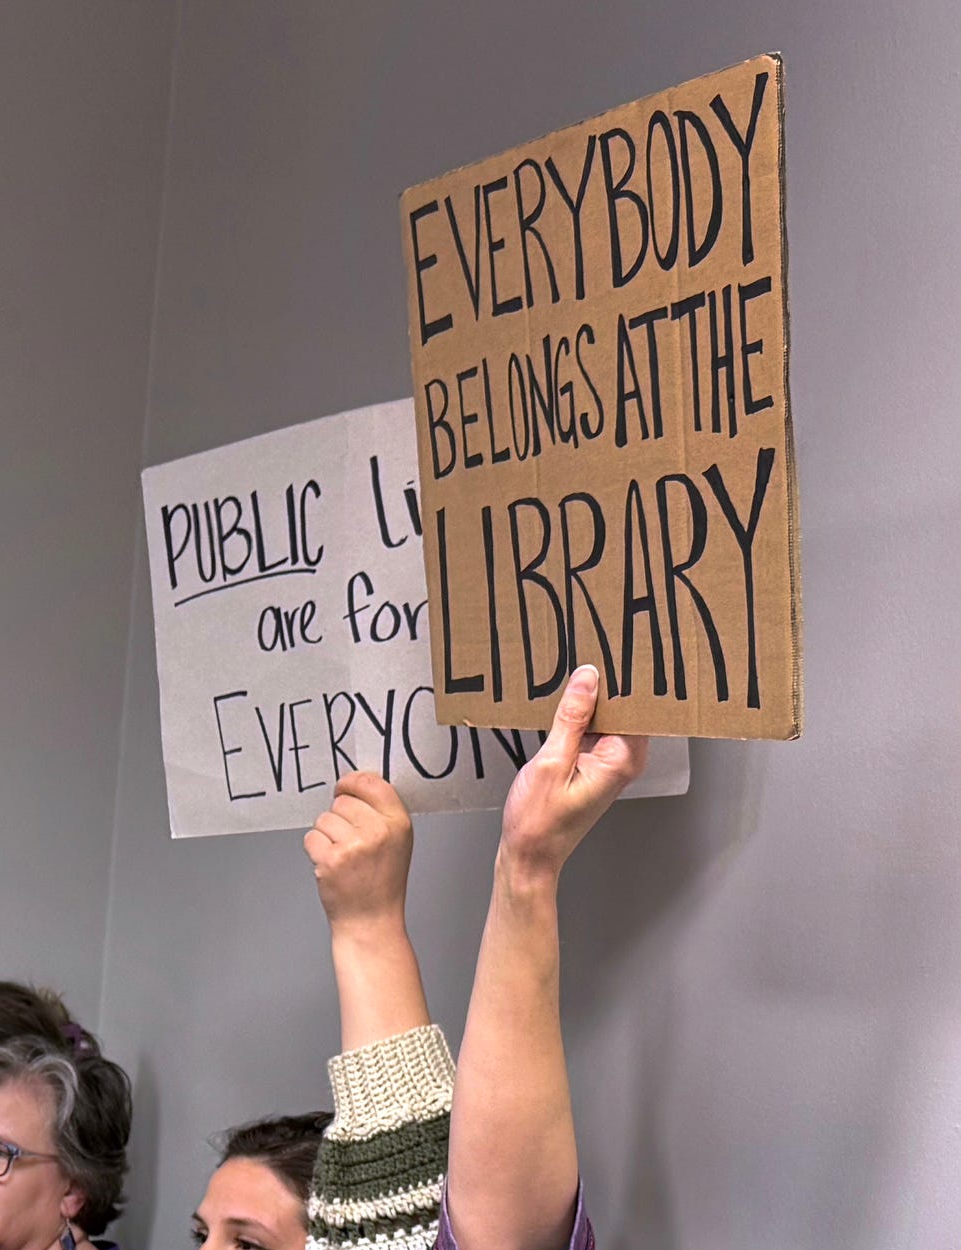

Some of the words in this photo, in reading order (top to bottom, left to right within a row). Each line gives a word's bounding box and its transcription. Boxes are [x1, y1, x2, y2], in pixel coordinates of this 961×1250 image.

[409, 72, 768, 347] EVERYBODY
[424, 323, 605, 480] BELONGS
[614, 305, 670, 449] AT
[671, 276, 775, 439] THE
[160, 479, 325, 590] PUBLIC
[257, 600, 323, 652] are
[342, 570, 429, 644] for
[436, 448, 775, 710] LIBRARY
[213, 686, 548, 801] EVERYON
